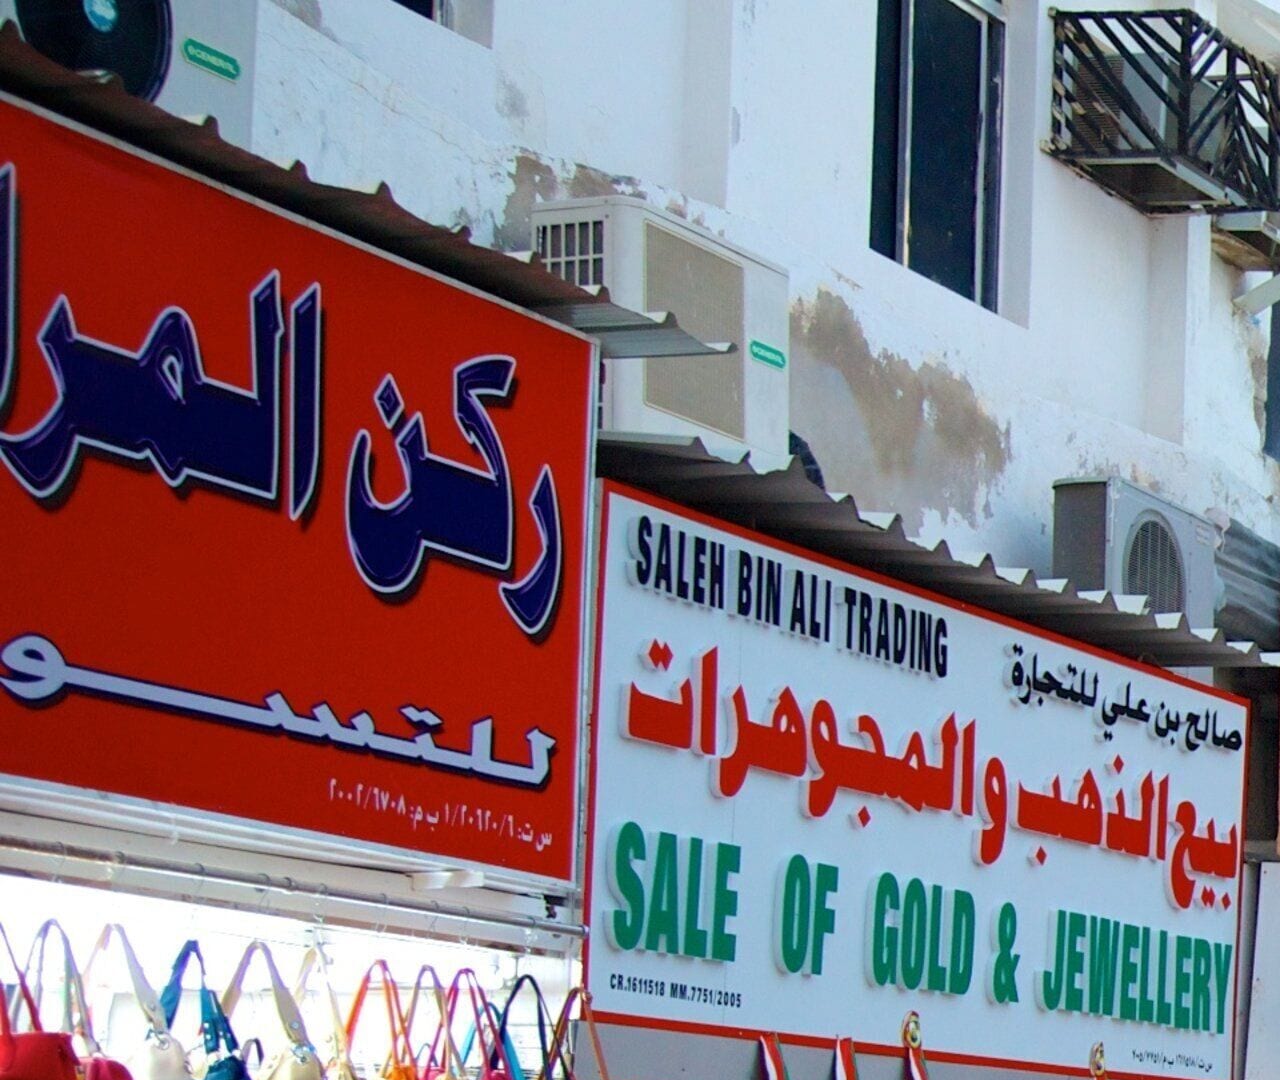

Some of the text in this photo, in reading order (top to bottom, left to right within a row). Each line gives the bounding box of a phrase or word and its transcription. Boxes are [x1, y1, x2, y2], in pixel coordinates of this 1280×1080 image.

[344, 354, 563, 635] ركن
[634, 513, 949, 679] SALEH BIN ALI TRADING
[1011, 642, 1243, 753] صالح بن علي للتجارة
[426, 809, 440, 832] ب
[535, 831, 553, 852] س
[1015, 752, 1171, 868] الذهب
[1165, 799, 1239, 911] بيع
[612, 820, 1235, 1035] SALE OF GOLD & JEWELLERY
[609, 973, 743, 1008] CR.1611518 MM.7751/2005
